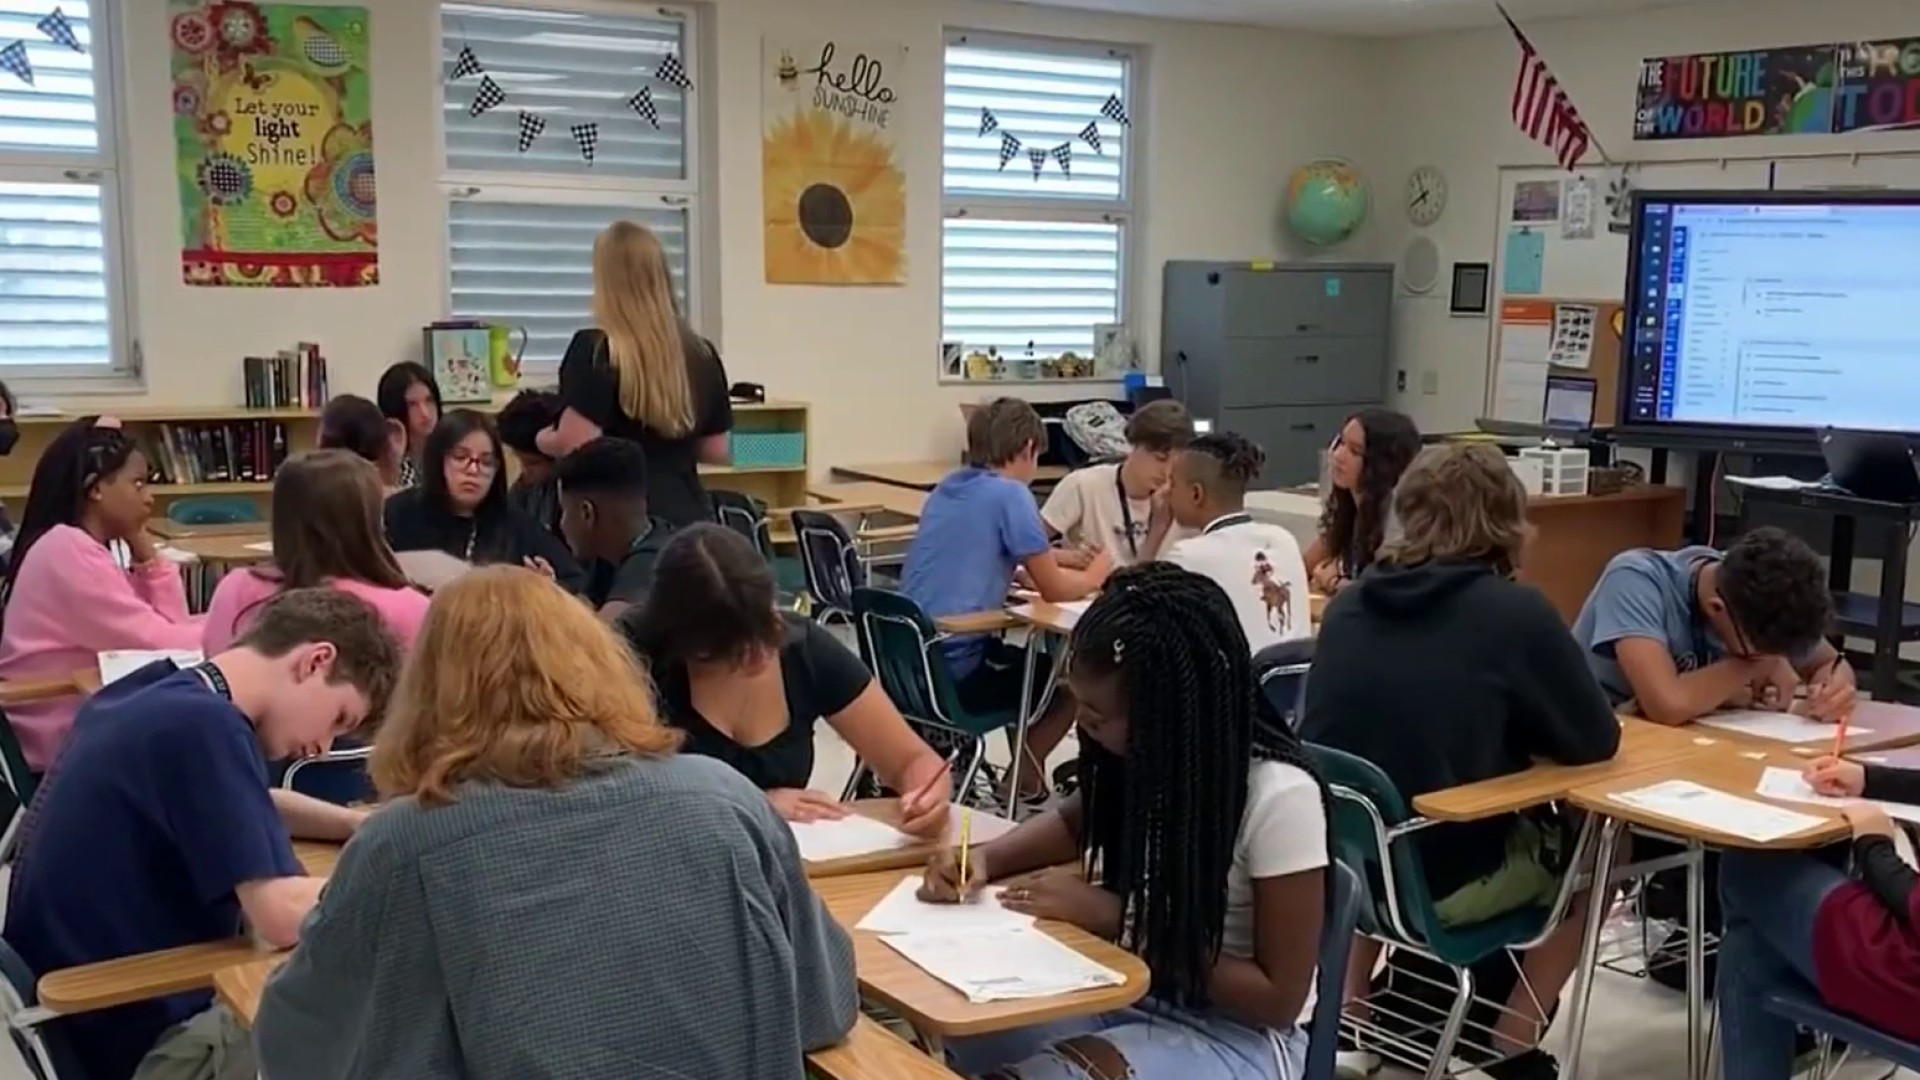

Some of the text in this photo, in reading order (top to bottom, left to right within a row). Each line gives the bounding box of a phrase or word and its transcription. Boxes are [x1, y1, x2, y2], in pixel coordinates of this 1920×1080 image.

[804, 41, 898, 103] hello
[1640, 52, 1768, 100] THE FUTURE
[234, 98, 320, 119] Let your
[813, 86, 891, 129] SUNSHINE
[1657, 99, 1766, 134] WORLD
[255, 117, 301, 144] light
[246, 143, 317, 165] Shine!
